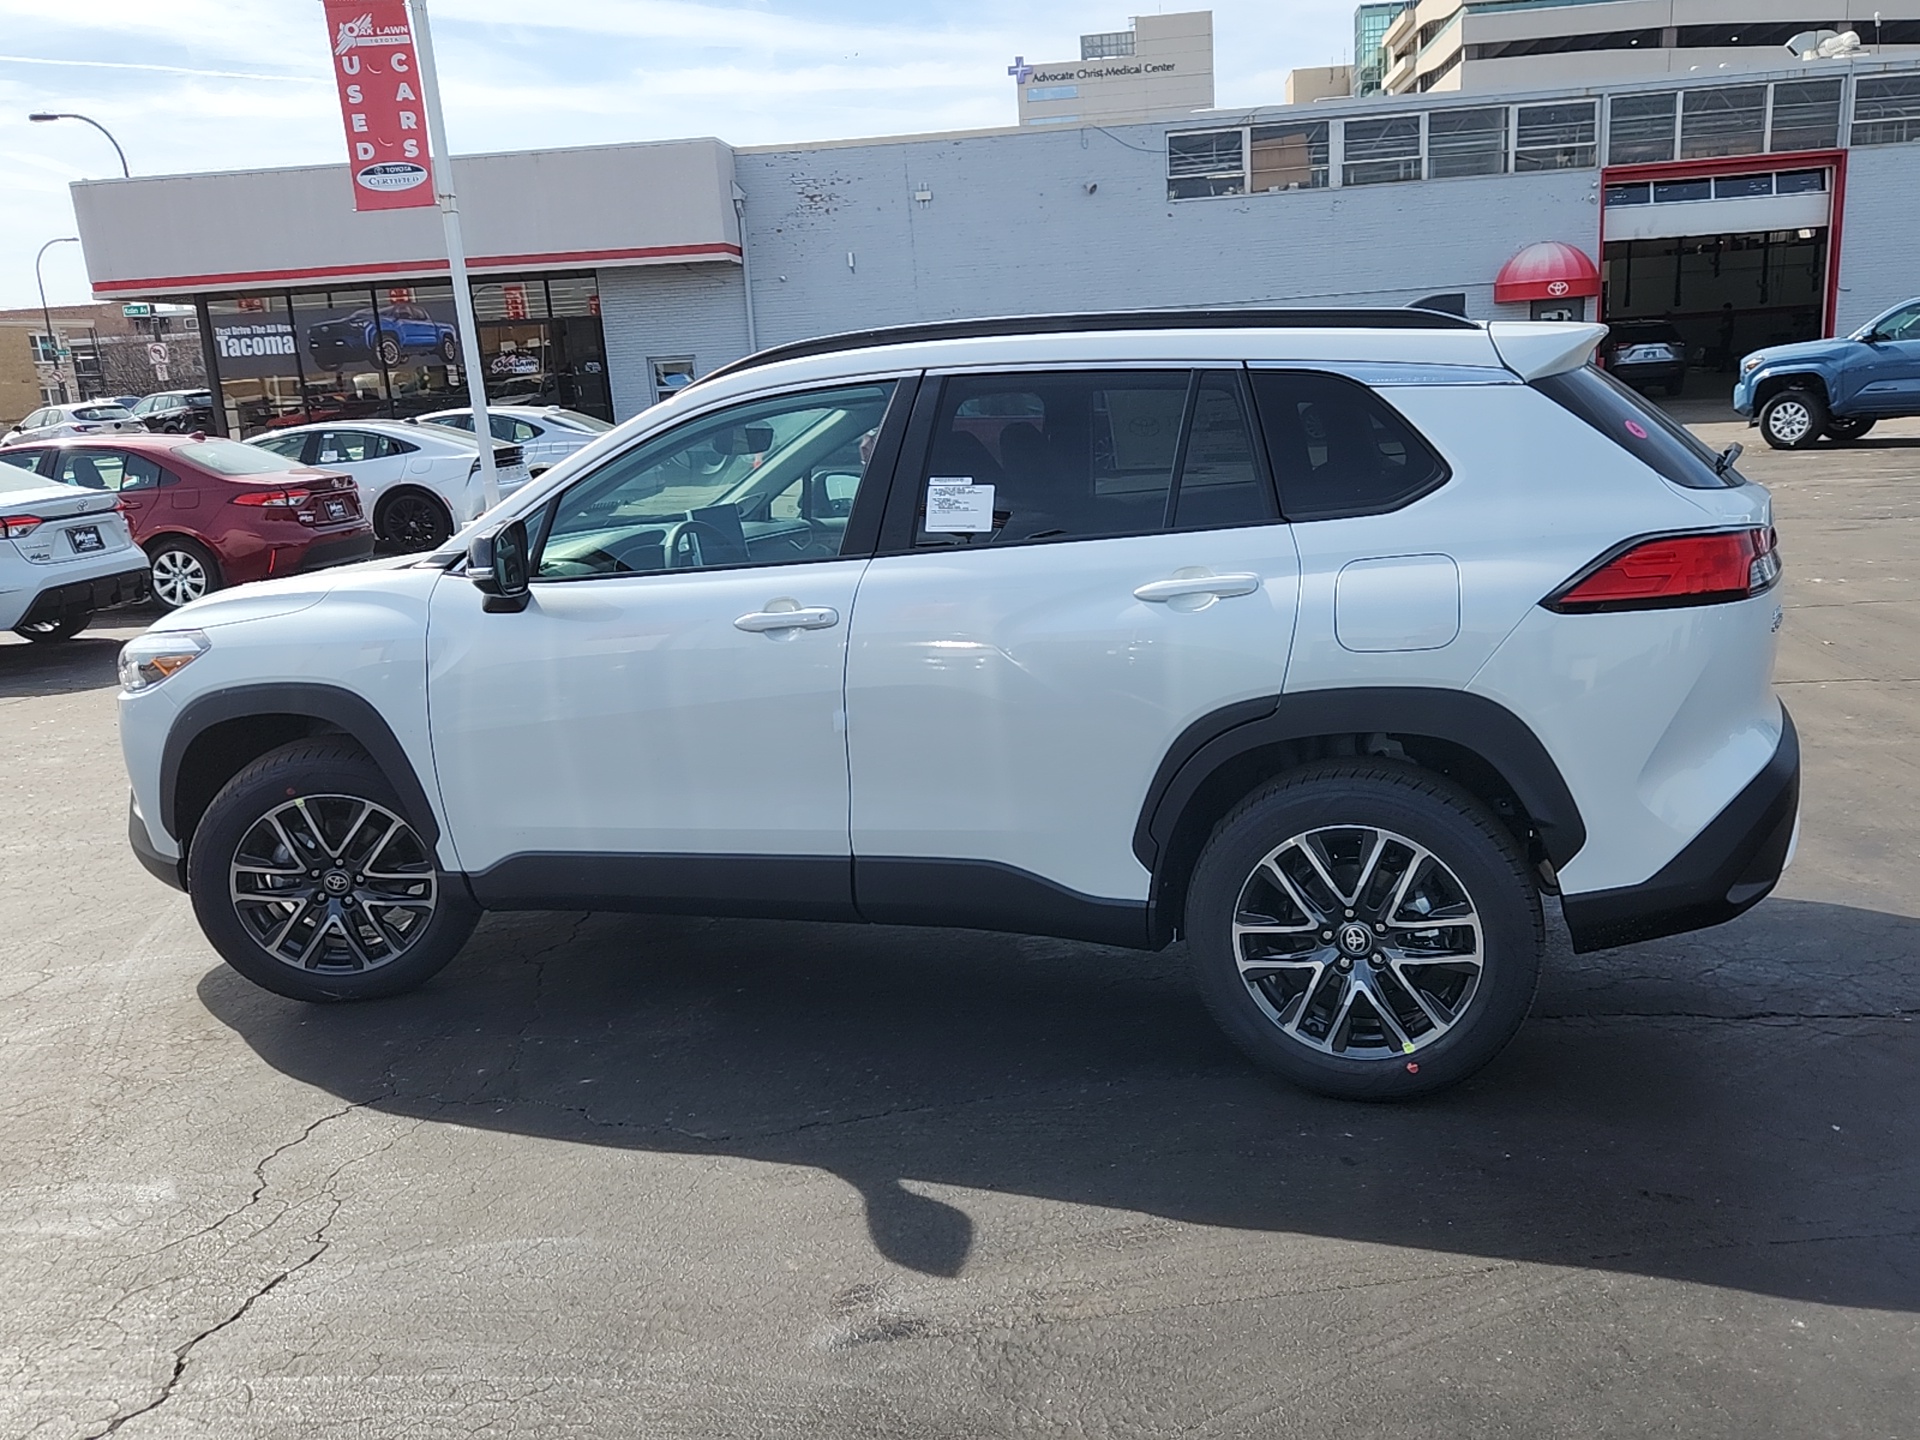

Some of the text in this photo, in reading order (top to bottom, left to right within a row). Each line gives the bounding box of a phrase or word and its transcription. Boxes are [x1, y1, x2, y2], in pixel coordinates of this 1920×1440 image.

[342, 22, 408, 37] OAK LAWN
[1032, 62, 1176, 83] Advocate Christ Medical Center
[341, 55, 376, 161] USED
[391, 53, 420, 159] CARS
[385, 165, 413, 174] TOYOTA
[214, 327, 232, 336] Test
[231, 325, 252, 335] Drive
[251, 323, 266, 334] The
[215, 335, 296, 357] Tacoma
